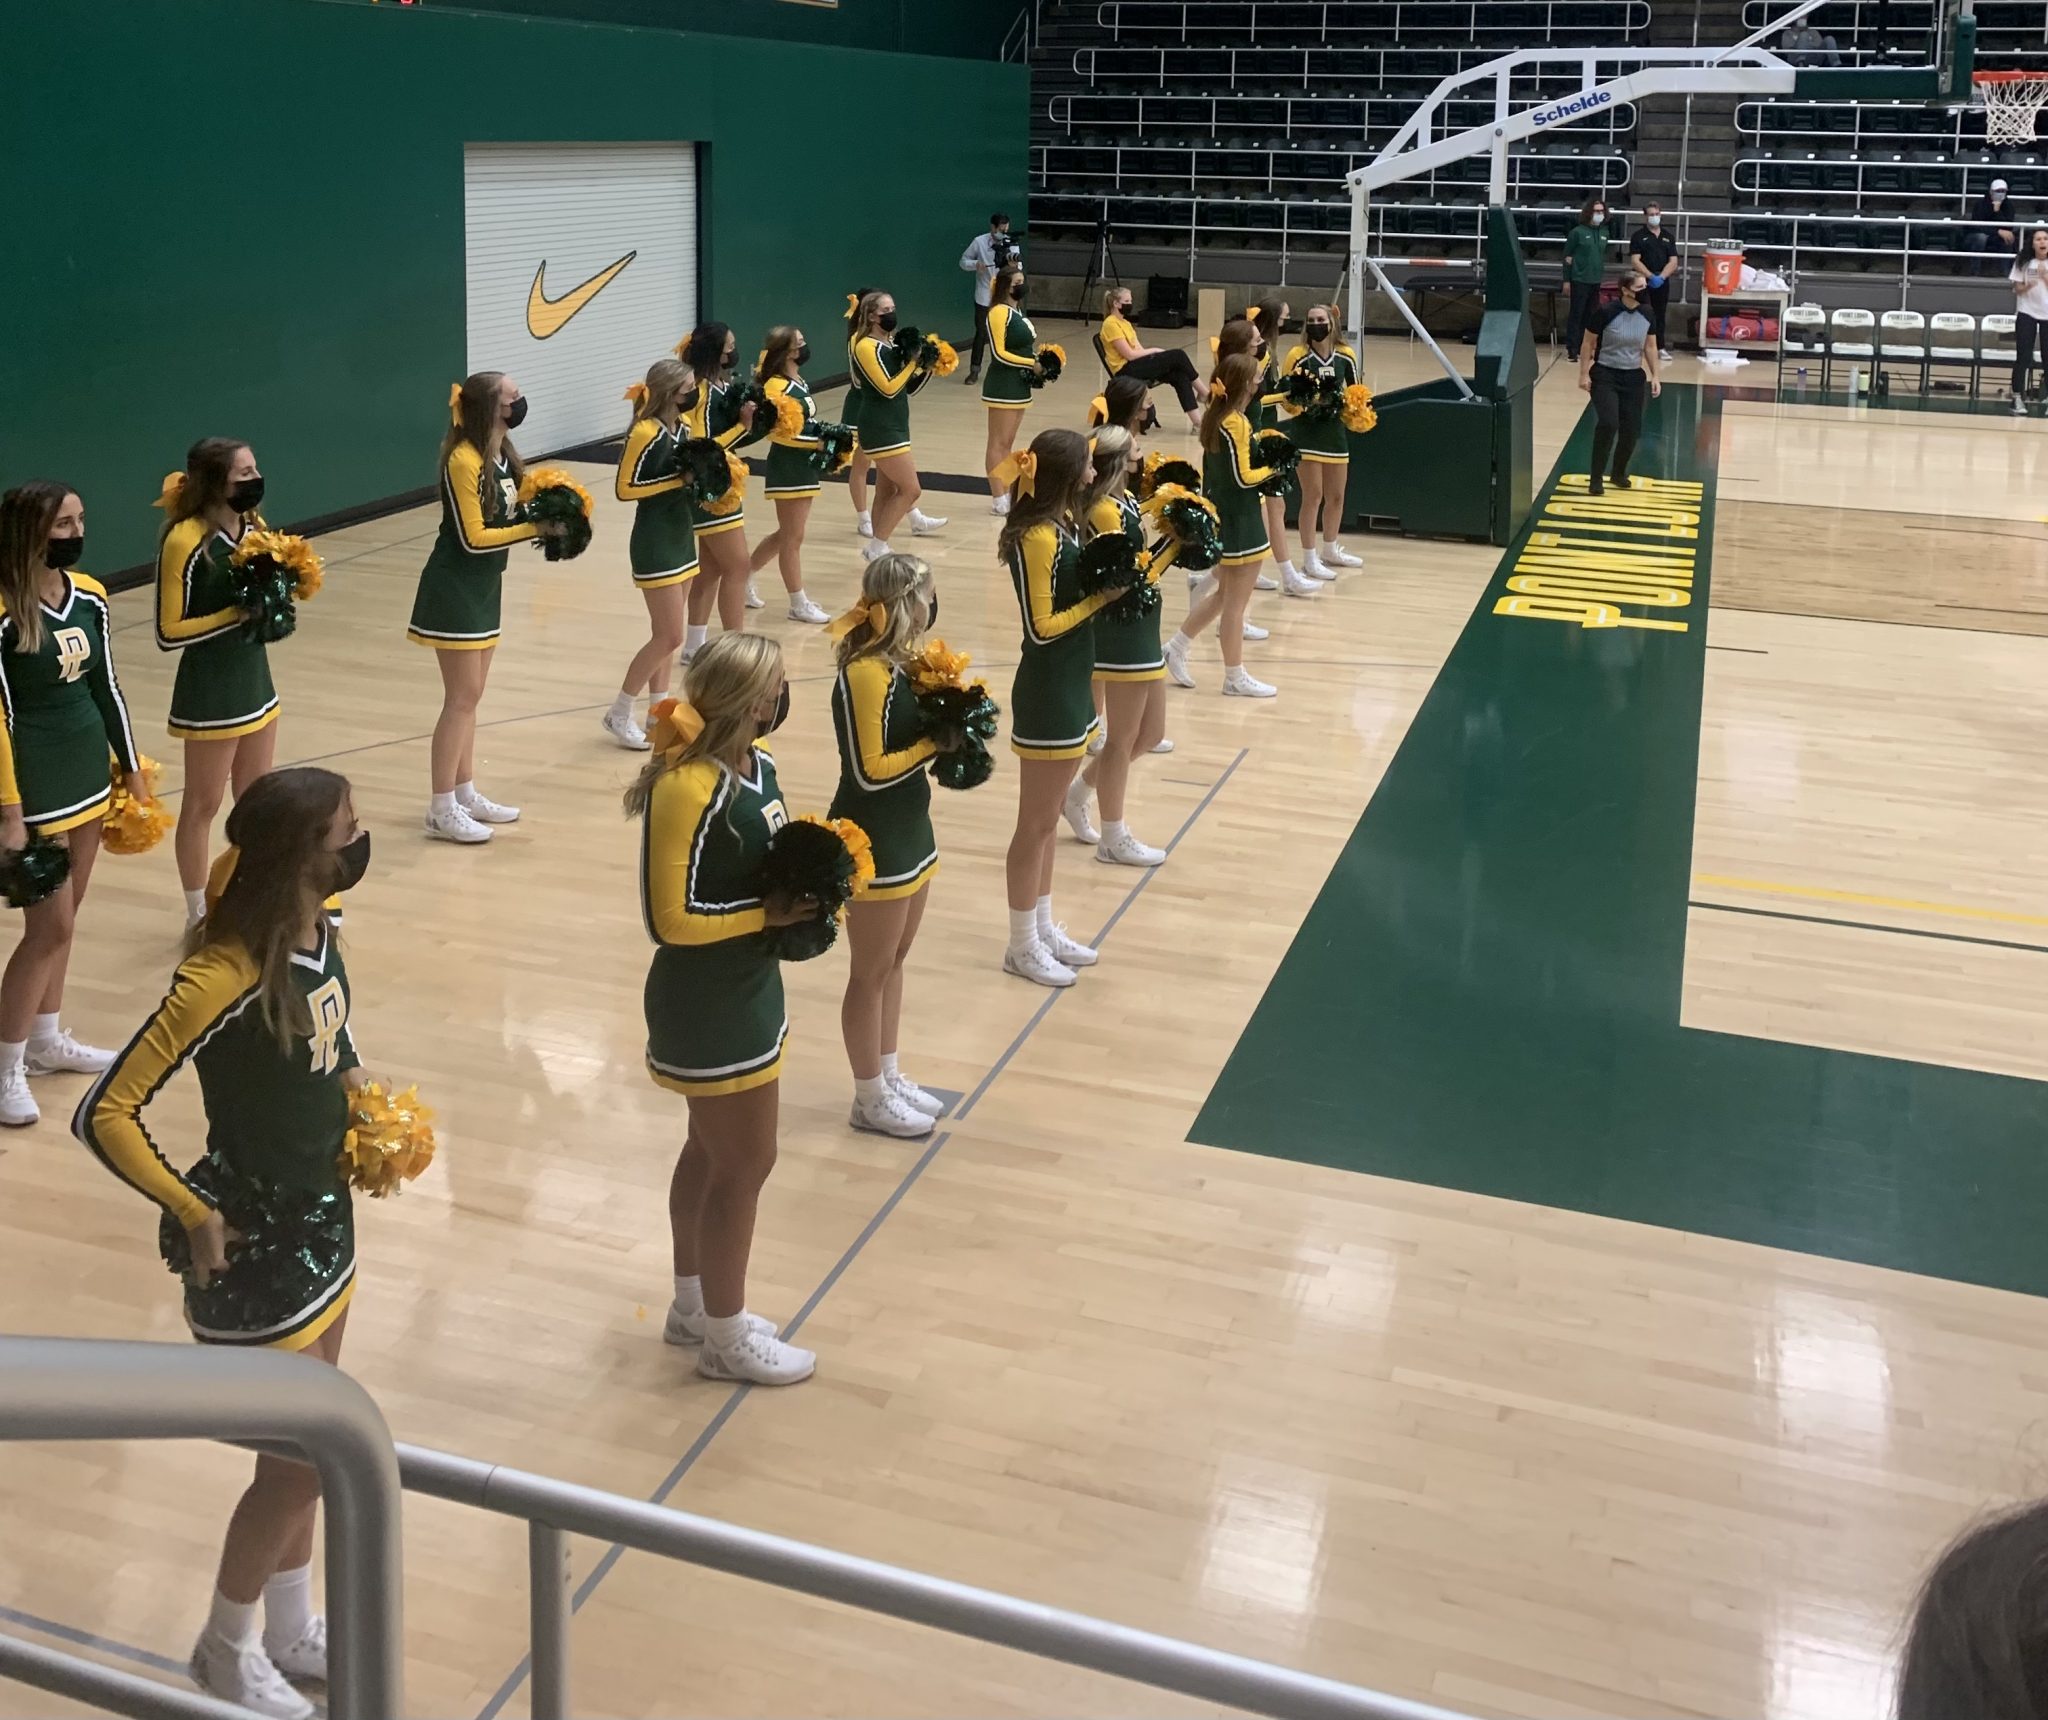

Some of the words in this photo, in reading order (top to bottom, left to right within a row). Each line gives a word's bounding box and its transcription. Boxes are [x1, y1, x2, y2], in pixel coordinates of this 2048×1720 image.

[1532, 91, 1612, 126] Schelde
[1717, 261, 1730, 274] G
[1492, 531, 1697, 633] POINT
